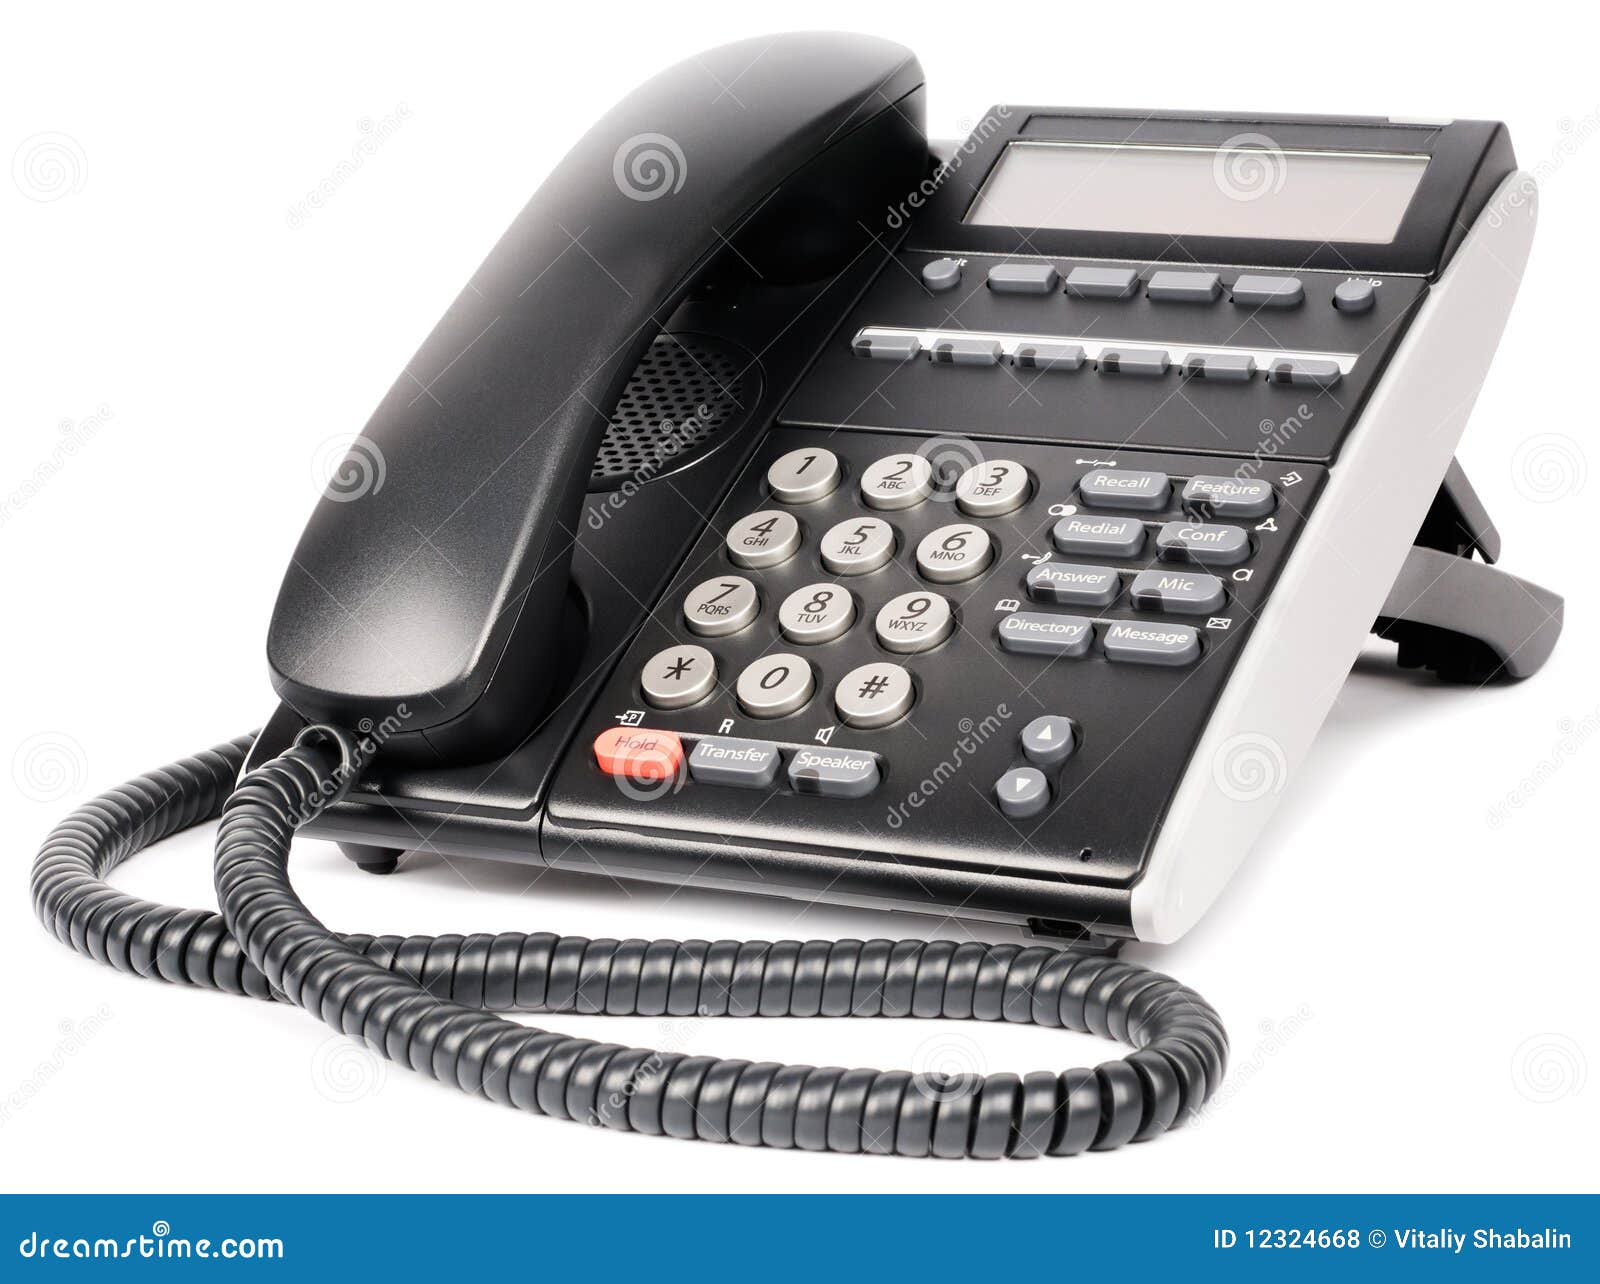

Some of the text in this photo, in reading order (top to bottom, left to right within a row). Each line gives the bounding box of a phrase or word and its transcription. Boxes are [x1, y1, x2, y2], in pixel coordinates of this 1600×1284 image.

[795, 456, 816, 475] 1
[882, 461, 912, 481] 2
[979, 467, 1009, 487] 3
[1093, 475, 1150, 489] Recall
[877, 481, 906, 490] ABC
[974, 487, 1002, 496] DEF
[1191, 480, 1261, 496] Feature
[750, 517, 779, 537] 4
[844, 525, 876, 545] 5
[1067, 521, 1127, 535] Redial
[743, 537, 769, 547] GHI
[942, 531, 972, 551] 6
[1178, 528, 1228, 543] Conf
[837, 545, 862, 555] JKL
[930, 550, 966, 561] MNO
[1035, 568, 1106, 584] Answer
[1158, 577, 1194, 592] Mic
[706, 584, 739, 604] 7
[696, 604, 731, 615] PQRS
[803, 592, 834, 613] 8
[899, 598, 931, 619] 9
[797, 613, 826, 624] TUV
[887, 620, 928, 632] WXYZ
[1005, 618, 1083, 636] Directory
[1112, 626, 1189, 645] Message
[759, 667, 789, 690] 0
[858, 675, 889, 699] #
[718, 718, 735, 734] R
[615, 736, 656, 750] Hold
[700, 744, 769, 762] Transfer
[797, 752, 870, 771] Speaker
